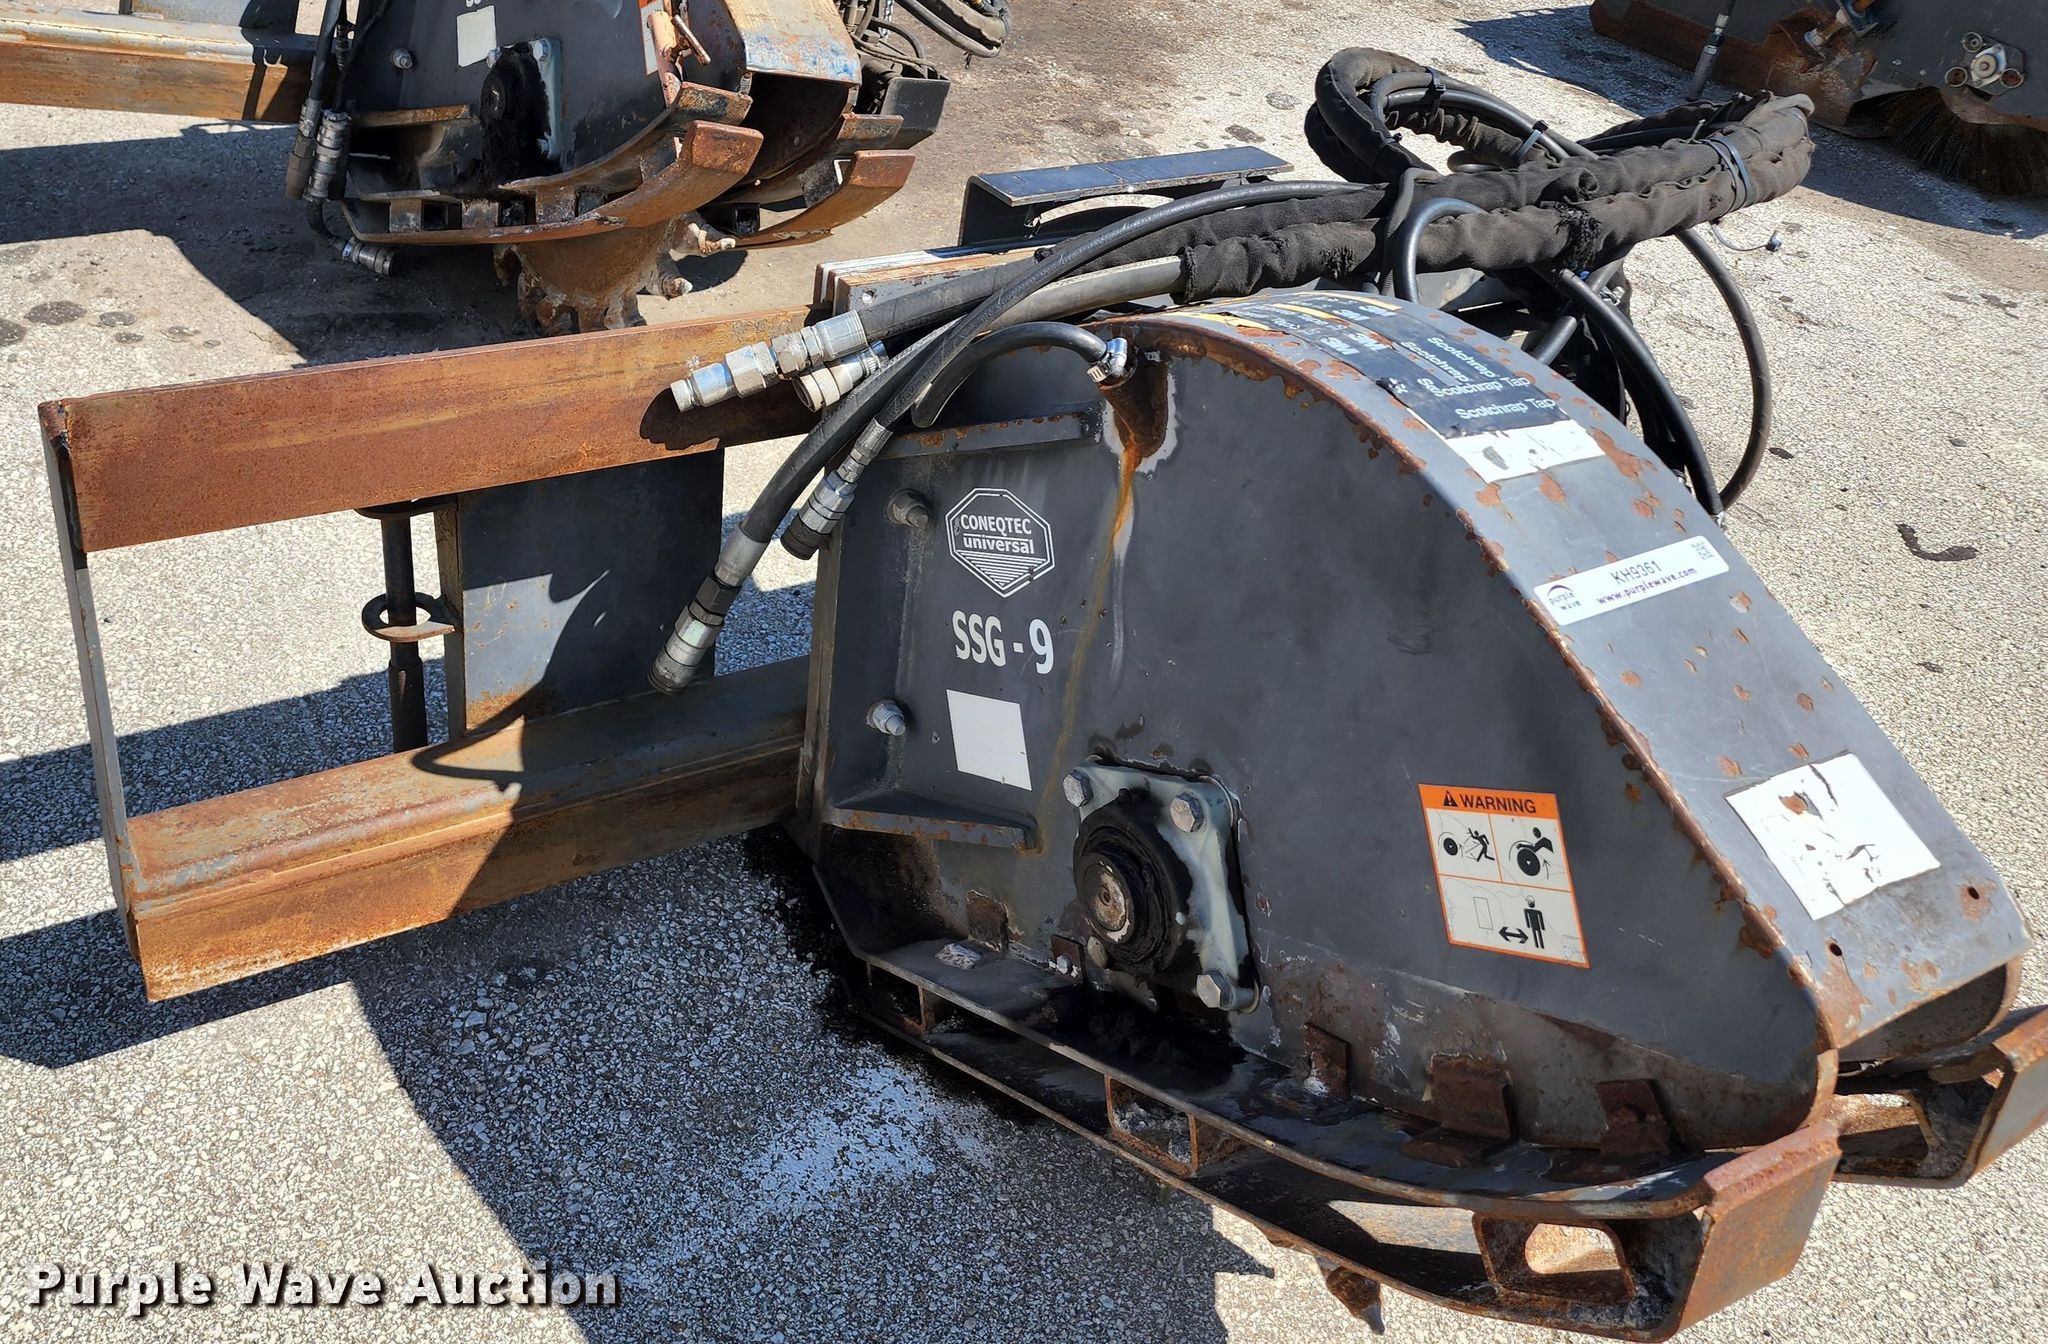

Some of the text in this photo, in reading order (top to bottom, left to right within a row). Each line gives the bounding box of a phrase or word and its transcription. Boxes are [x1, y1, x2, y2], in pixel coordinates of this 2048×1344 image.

[1320, 336, 1359, 355] 3M
[1346, 332, 1388, 351] 3M
[1400, 341, 1473, 382] Scotchrap
[1427, 336, 1500, 378] Scotchrap
[1433, 379, 1503, 397] Scotchrap
[1455, 402, 1529, 419] Scotchrap
[960, 514, 1032, 537] CONEQTEC
[963, 534, 1035, 554] universal
[1610, 560, 1662, 585] KH9361
[1596, 566, 1699, 604] www.purplewave.com
[1549, 591, 1576, 606] purple
[1560, 600, 1583, 611] wave
[1459, 793, 1537, 814] WARNING
